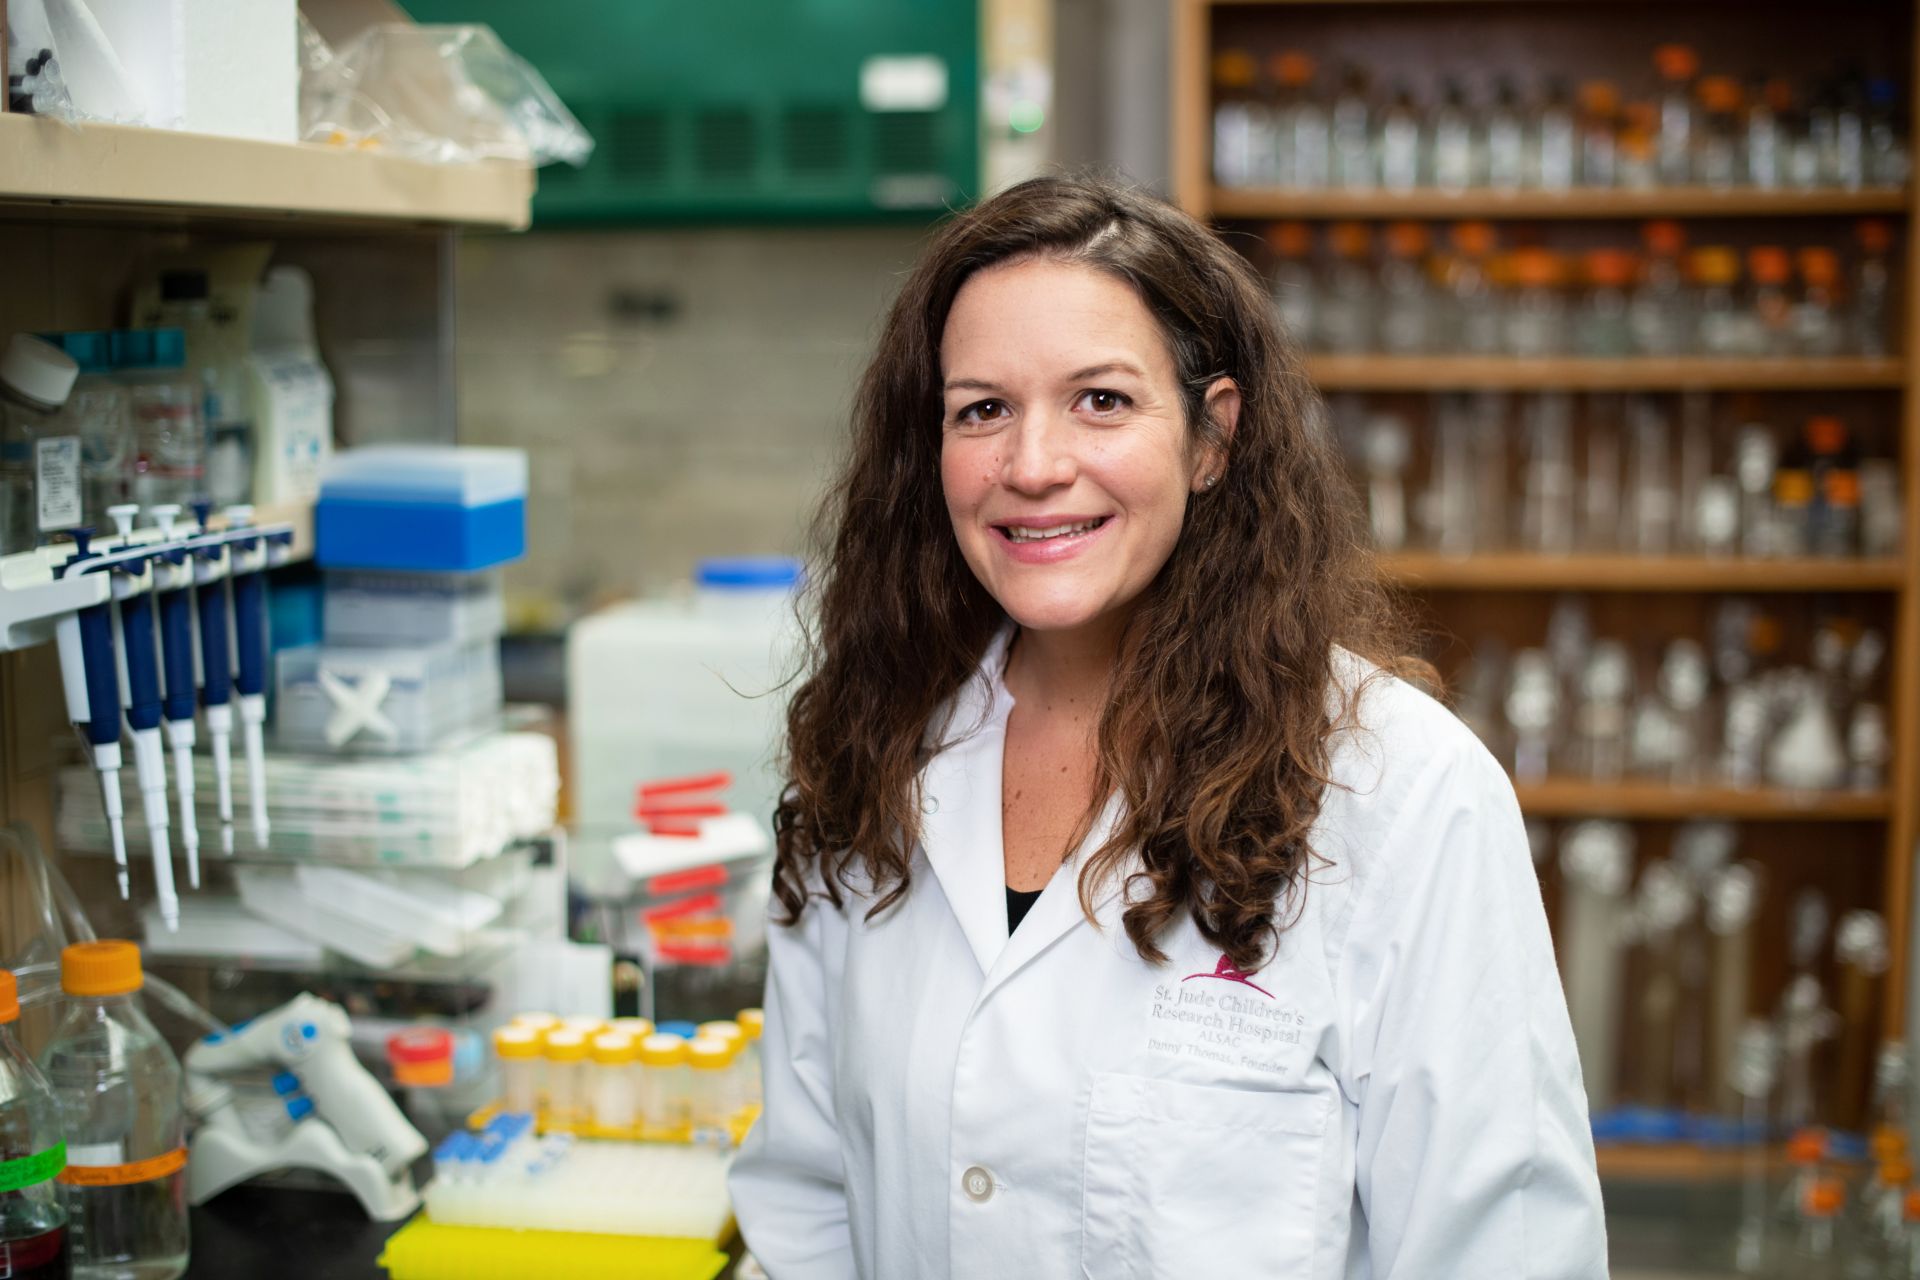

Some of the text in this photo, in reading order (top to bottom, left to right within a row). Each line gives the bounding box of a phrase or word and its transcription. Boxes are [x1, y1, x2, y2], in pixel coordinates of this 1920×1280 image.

[1151, 1003, 1301, 1044] Research Hospital
[1154, 985, 1305, 1026] St. Jude Children's
[1147, 1038, 1182, 1054] Danny
[1241, 1055, 1289, 1075] Founder
[1199, 1030, 1241, 1048] ALSAC
